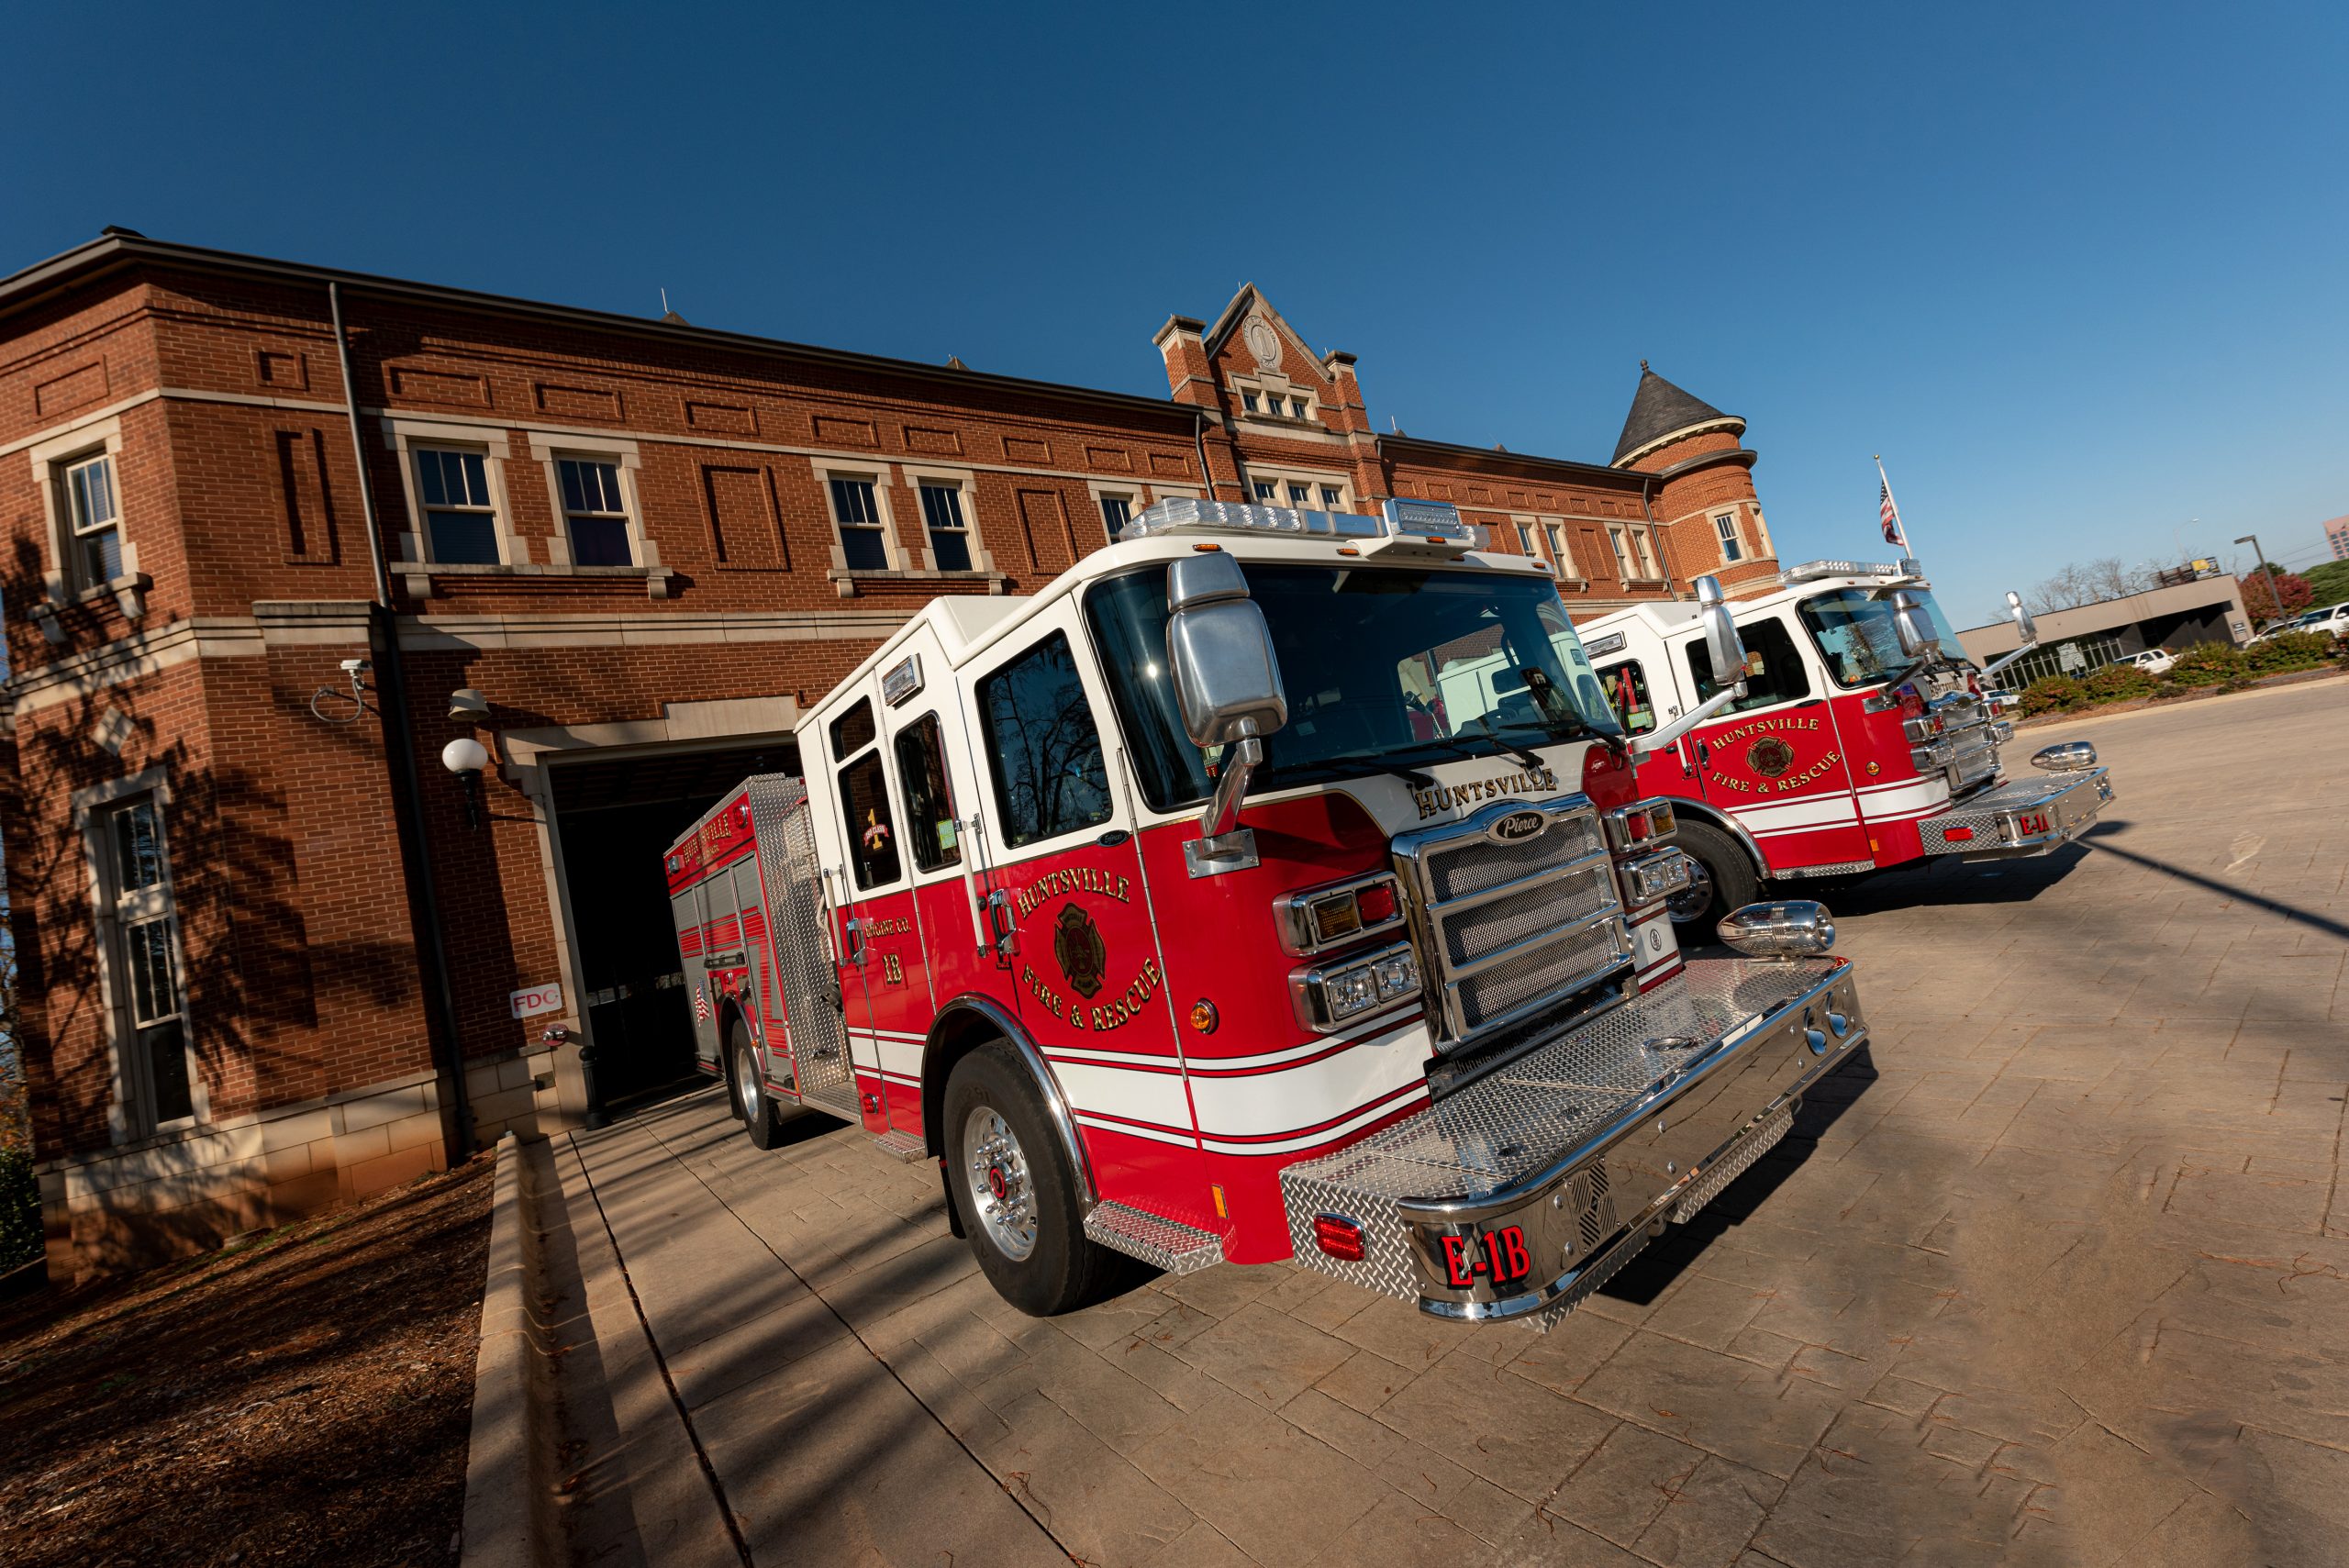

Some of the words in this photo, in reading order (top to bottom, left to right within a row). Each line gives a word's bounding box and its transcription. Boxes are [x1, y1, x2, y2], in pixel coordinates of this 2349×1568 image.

[1712, 718, 1820, 751] HUNTSVILLE
[1415, 768, 1557, 820] HUNTSVILLE
[1711, 772, 1750, 792] FIRE
[1757, 783, 1770, 794] &
[1776, 751, 1841, 792] RESCUE
[1503, 816, 1539, 838] Pierce
[1018, 867, 1130, 918] HUNTSVILLE
[864, 919, 895, 939] ENGINE
[896, 917, 911, 934] CO.
[513, 989, 559, 1012] FDC
[1021, 963, 1063, 1018] FIRE
[1070, 1005, 1085, 1029] &
[1090, 957, 1163, 1031] RESCUE
[1438, 1225, 1531, 1291] E-1B
